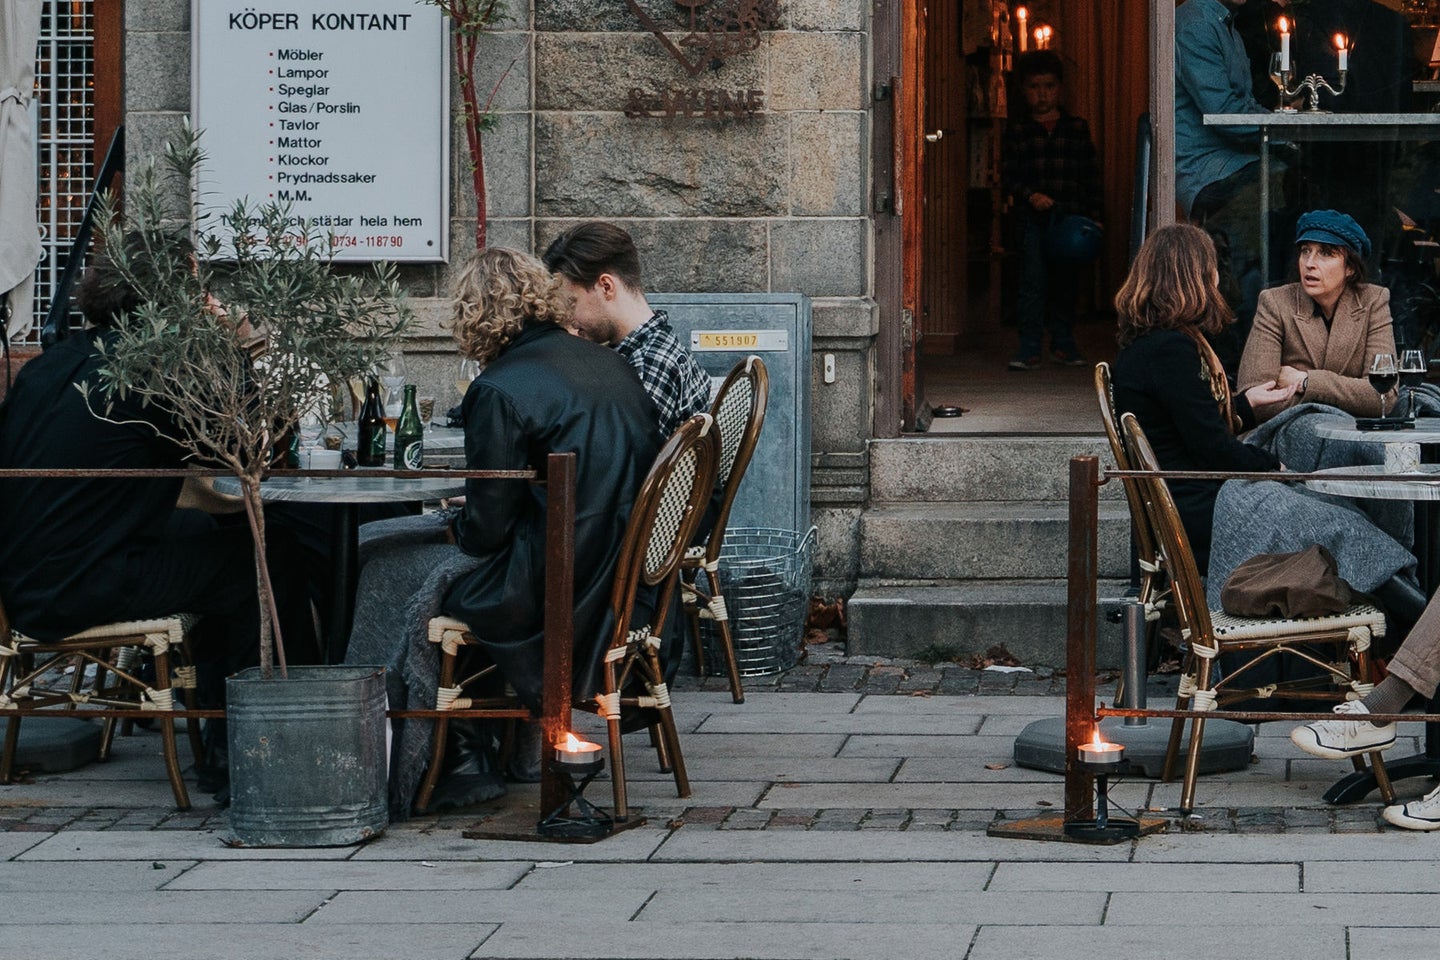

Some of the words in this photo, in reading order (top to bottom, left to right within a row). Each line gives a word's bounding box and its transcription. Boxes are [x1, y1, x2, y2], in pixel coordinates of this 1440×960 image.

[229, 7, 299, 30] KÖPER
[312, 13, 412, 31] KONTANT
[277, 48, 324, 61] Möbler
[277, 66, 330, 82] Lampor
[278, 83, 330, 100] Speglar
[279, 119, 320, 131] Tavlor
[277, 136, 322, 149] Mattor
[278, 154, 330, 166] Klockor
[277, 171, 377, 187] Prydnadssaker
[277, 190, 313, 202] M.M.
[312, 215, 354, 227] städar
[360, 215, 388, 227] hela
[393, 215, 423, 227] hem
